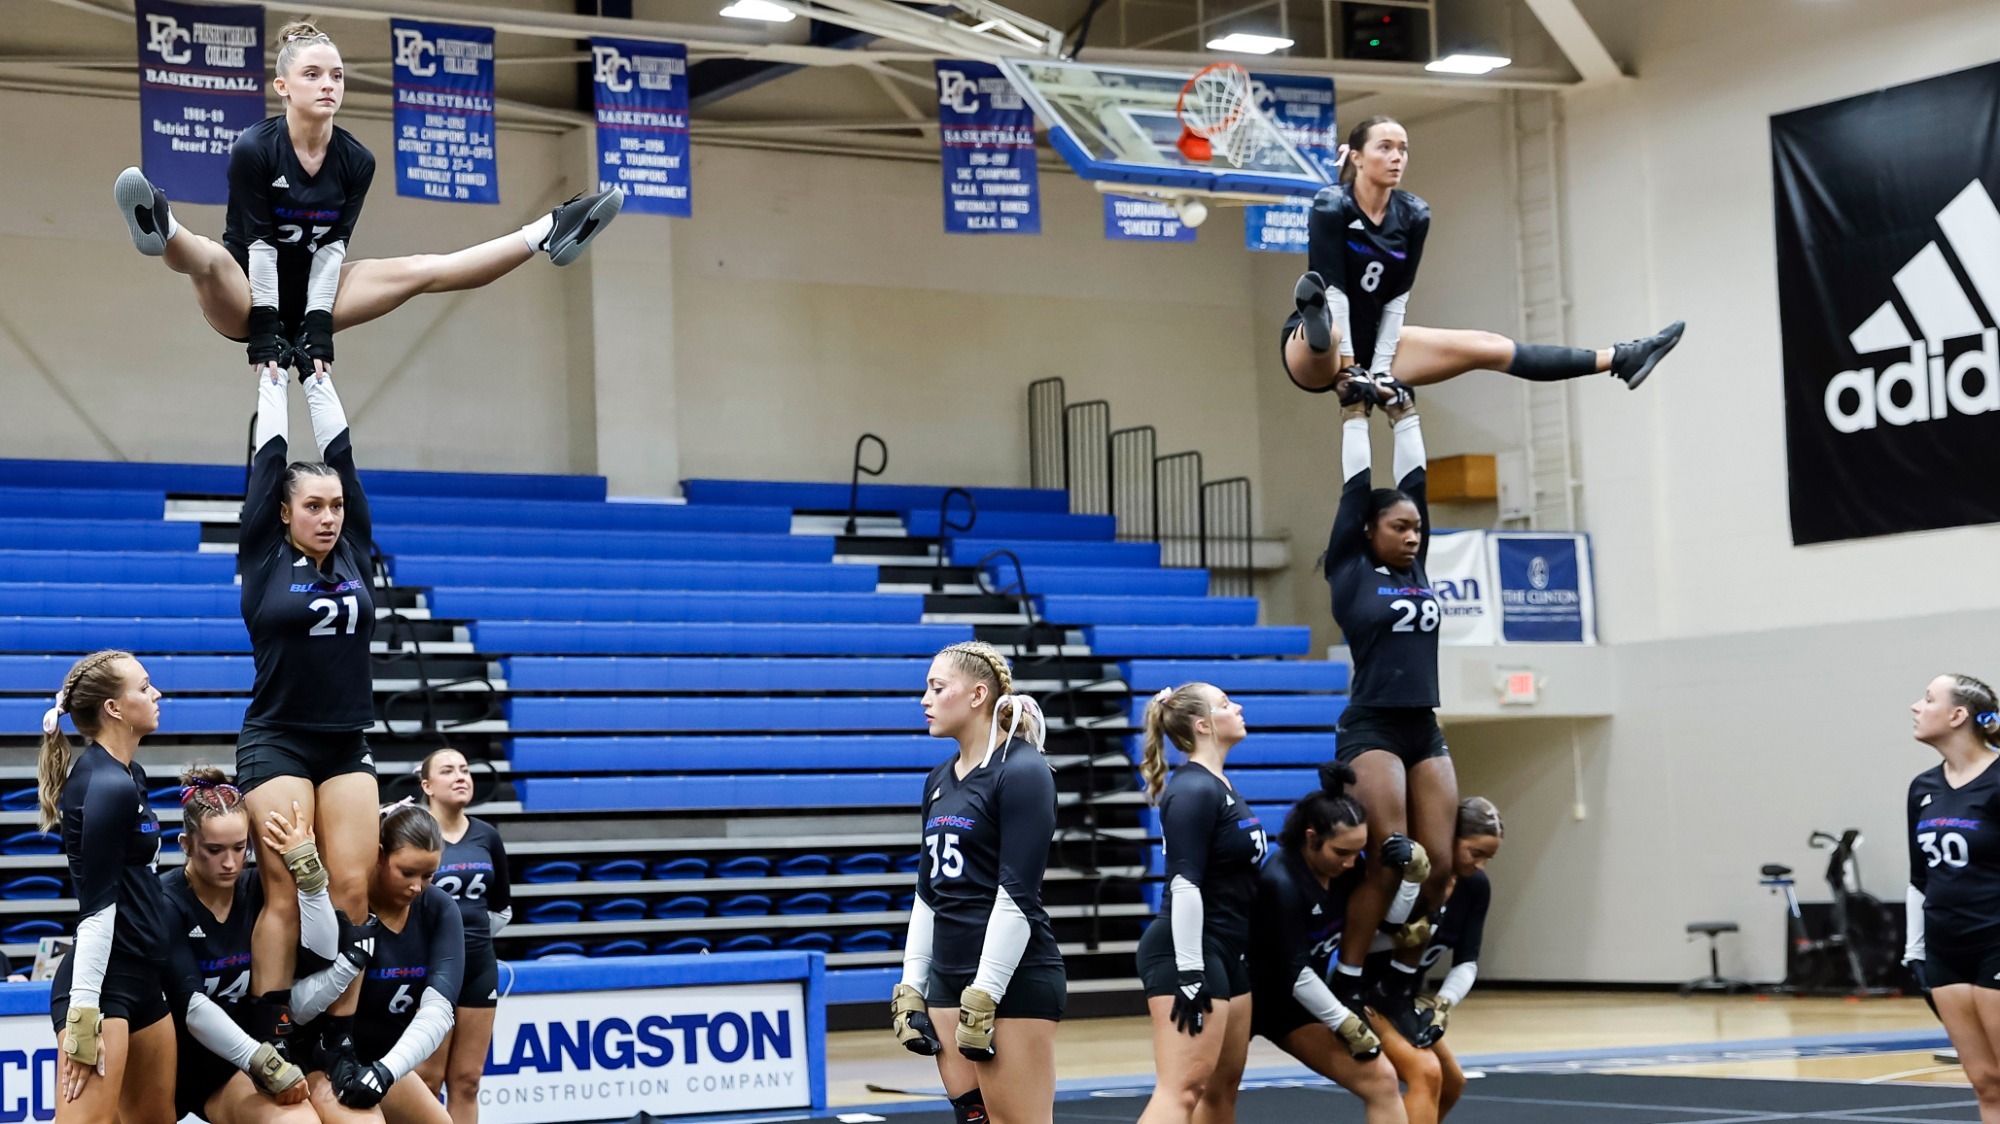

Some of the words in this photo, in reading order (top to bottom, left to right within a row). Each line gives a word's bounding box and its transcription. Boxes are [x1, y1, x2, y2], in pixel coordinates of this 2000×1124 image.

[145, 69, 258, 91] BASKETBALL
[399, 89, 492, 111] BASKETBALL
[598, 109, 685, 128] BASKETBALL
[944, 129, 1033, 145] BASKETBALL
[1360, 261, 1384, 293] 8
[1502, 589, 1526, 604] THE
[309, 595, 359, 636] 21
[1390, 598, 1440, 632] 28
[1917, 831, 1969, 869] 30
[435, 873, 487, 900] 26
[203, 970, 251, 1004] 14
[388, 984, 414, 1014] 6
[480, 1079, 669, 1107] CONSTRUCTION
[687, 1071, 795, 1093] COMPANY
